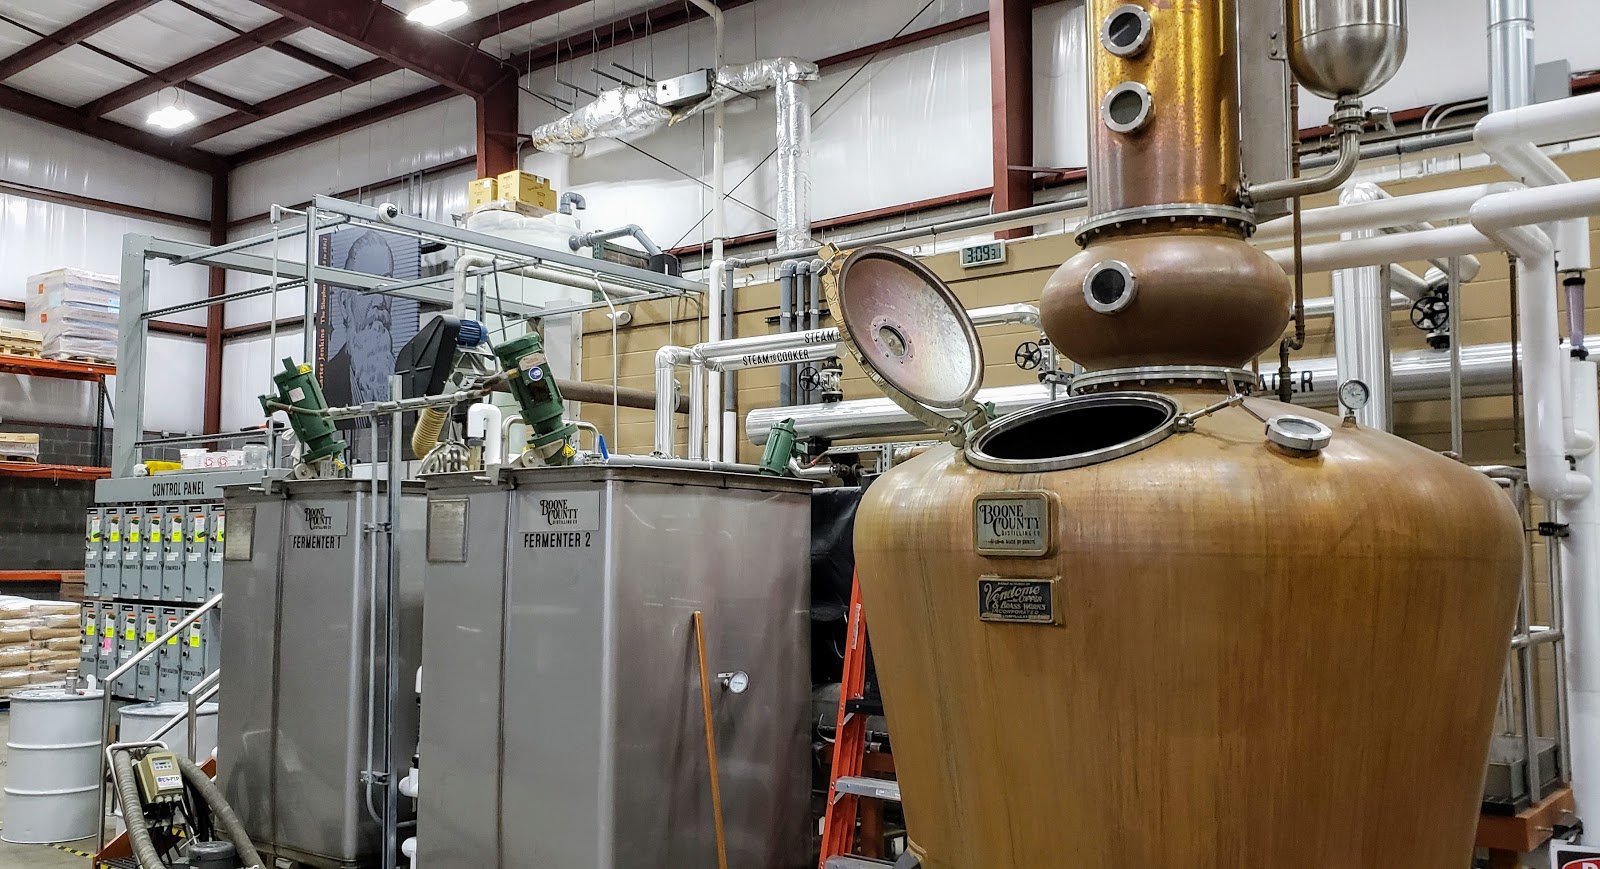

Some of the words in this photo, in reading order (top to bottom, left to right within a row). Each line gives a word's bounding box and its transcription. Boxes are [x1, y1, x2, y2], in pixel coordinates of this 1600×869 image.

[804, 329, 834, 344] STEAM
[742, 353, 770, 366] STEAM
[776, 349, 810, 363] COOKER
[152, 482, 181, 497] CONTROL
[183, 480, 205, 496] PANEL
[304, 507, 325, 521] BOONE
[540, 499, 568, 516] BOONE
[979, 504, 1024, 525] BOONE
[309, 515, 333, 530] COUNTY
[547, 508, 579, 526] COUNTY
[992, 516, 1041, 537] COUNTY
[292, 535, 335, 549] FERMENTER
[337, 535, 341, 549] 1
[523, 532, 581, 548] FERMENTER
[585, 531, 591, 547] 2
[983, 582, 1041, 611] Vendome
